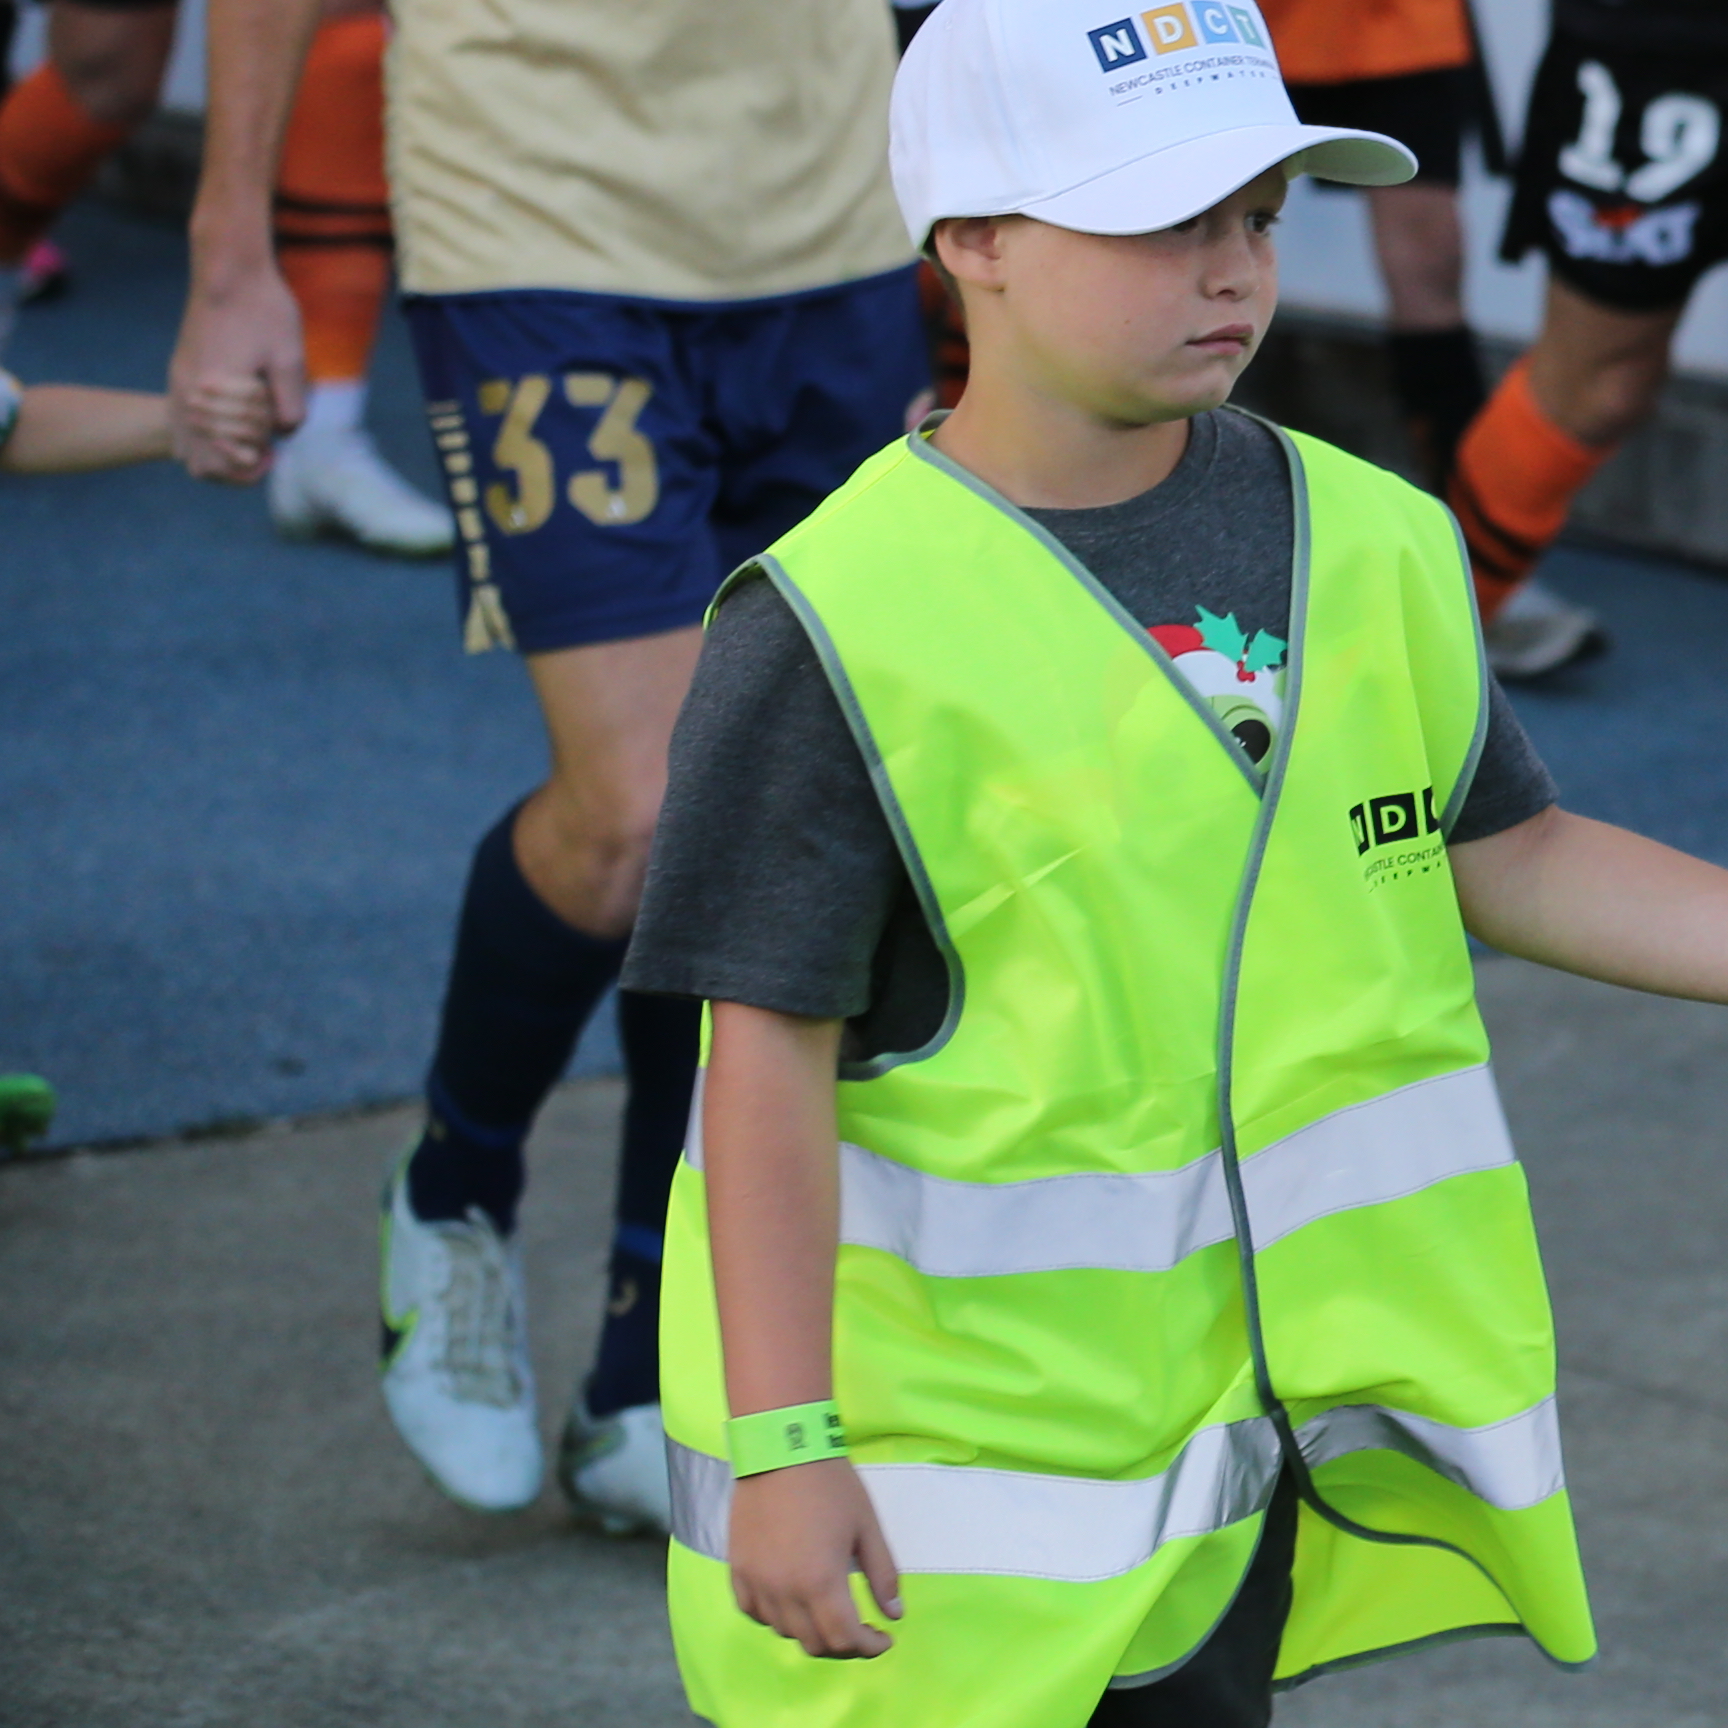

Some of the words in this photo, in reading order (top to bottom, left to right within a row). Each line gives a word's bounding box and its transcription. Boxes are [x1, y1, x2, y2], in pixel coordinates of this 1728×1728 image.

[1091, 4, 1263, 69] NDCT
[1109, 65, 1183, 96] NEWCASTLE
[1557, 58, 1722, 200] 19
[477, 373, 659, 536] 33
